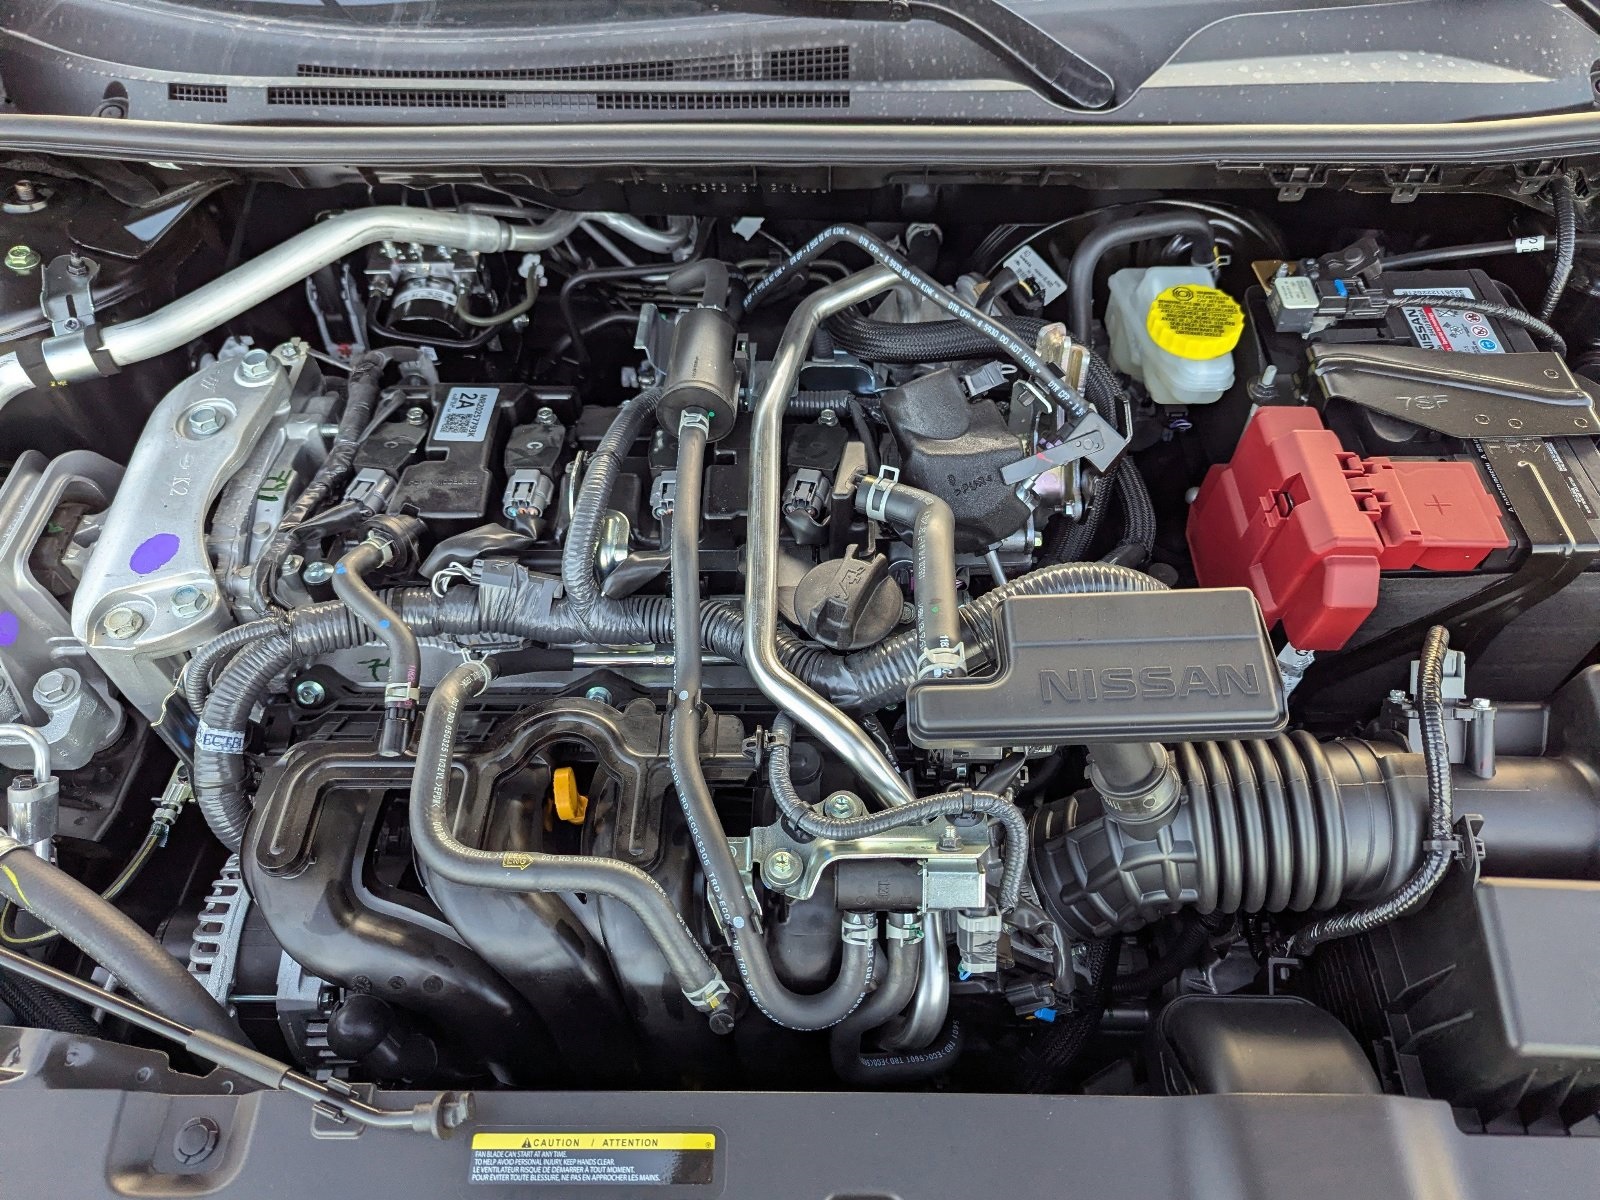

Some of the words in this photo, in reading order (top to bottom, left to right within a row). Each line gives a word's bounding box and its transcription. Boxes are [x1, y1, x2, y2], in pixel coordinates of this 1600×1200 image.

[920, 282, 935, 296] KINK
[1008, 342, 1022, 356] NOT
[1020, 353, 1038, 370] KINK
[456, 392, 478, 409] 2A
[1039, 663, 1260, 702] NISSAN
[534, 1138, 580, 1147] CAUTION
[602, 1138, 658, 1147] ATTENTION
[475, 1150, 486, 1158] FAN
[487, 1150, 504, 1158] BLADE
[504, 1150, 516, 1158] CAN
[517, 1150, 533, 1158] START
[533, 1150, 541, 1158] AT
[541, 1150, 552, 1158] ANY
[475, 1158, 482, 1166] TO
[483, 1158, 496, 1166] HELP
[497, 1158, 514, 1166] AVOID
[515, 1158, 543, 1166] PERSONAL
[563, 1158, 576, 1166] KEEP
[577, 1158, 596, 1166] HANDS
[472, 1174, 490, 1182] POUR
[510, 1174, 530, 1182] TOUTE
[561, 1174, 570, 1182] NE
[570, 1174, 582, 1182] PAS
[582, 1174, 591, 1182] EN
[592, 1174, 628, 1182] APPROCHER
[628, 1174, 638, 1182] LES
